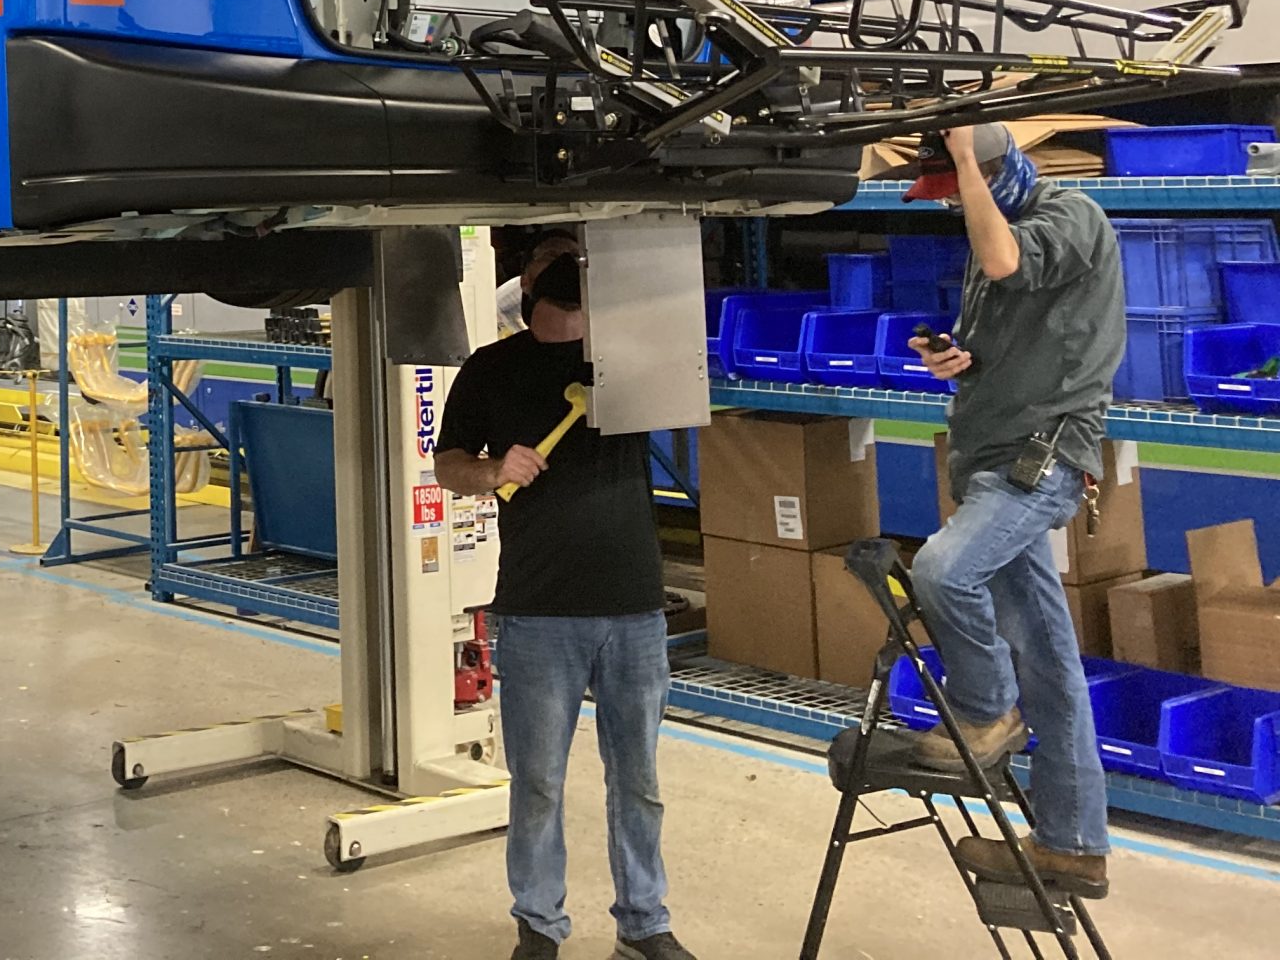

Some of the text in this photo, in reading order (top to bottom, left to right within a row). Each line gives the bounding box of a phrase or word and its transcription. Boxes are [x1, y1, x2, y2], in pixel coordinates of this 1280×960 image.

[415, 368, 434, 459] stertil
[415, 487, 442, 505] 18500
[421, 506, 436, 521] lbs
